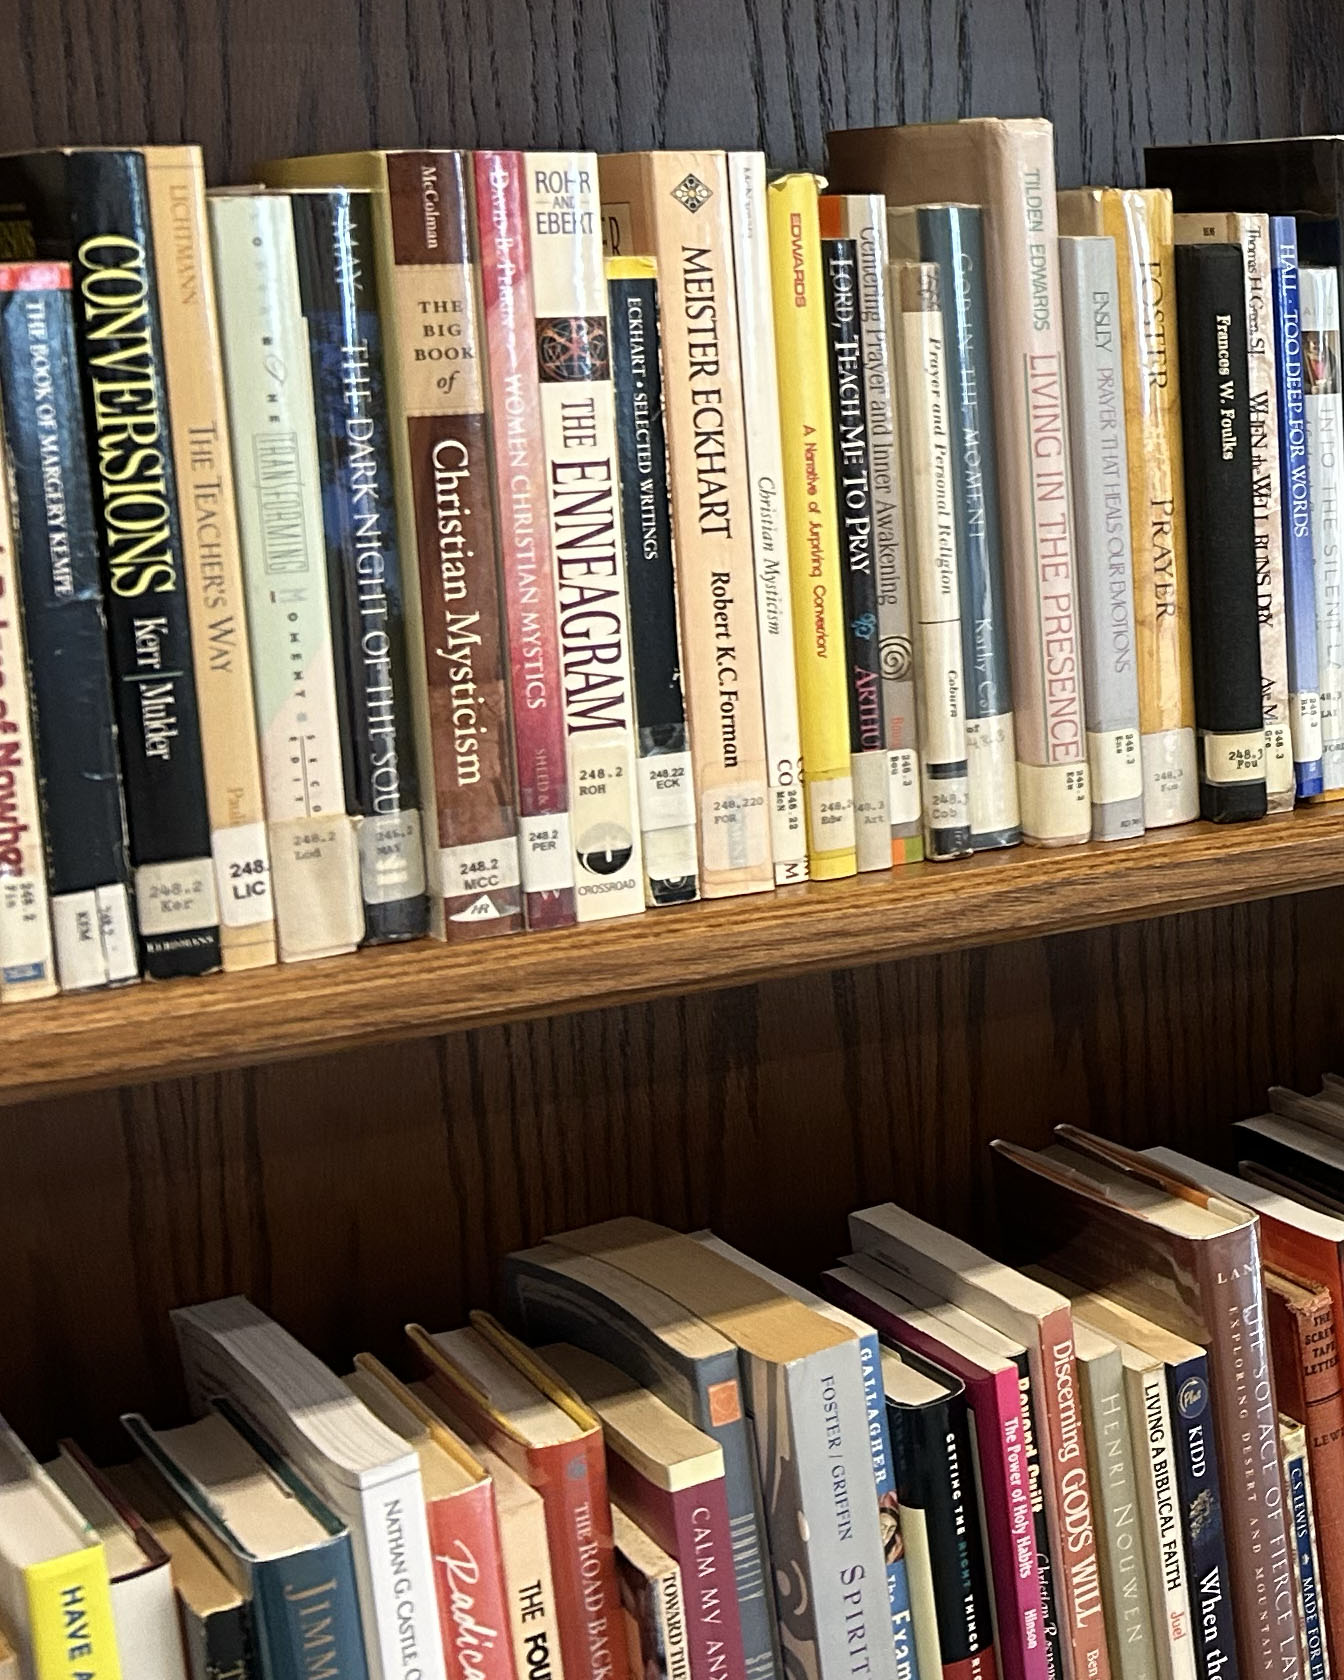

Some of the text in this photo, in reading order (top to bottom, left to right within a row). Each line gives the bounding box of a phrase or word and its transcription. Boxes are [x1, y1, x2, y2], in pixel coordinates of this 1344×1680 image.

[420, 165, 439, 250] McColman
[536, 171, 590, 193] ROHR
[536, 212, 593, 235] EBERT
[552, 196, 575, 207] AND
[418, 300, 464, 314] THE
[790, 212, 806, 308] EDWARDS
[1023, 168, 1050, 331] TILDEN EDWARDS
[414, 345, 475, 361] BOOK
[423, 323, 462, 338] BIG
[436, 371, 459, 392] of
[681, 245, 732, 540] MEISTER ECKHART
[1216, 315, 1235, 461] Frances W. Foulks
[77, 235, 177, 599] CONVERSIONS
[628, 297, 658, 560] ECKHART SELECTED WRITINGS
[830, 259, 872, 575] LORD, TEACH ME TO PRAY
[430, 439, 486, 787] Christian Mysticism
[551, 398, 627, 734] THE ENNEAGRAM
[710, 571, 730, 643] Robert
[1027, 353, 1079, 761] LIVING IN THE PRESENCE
[1151, 498, 1175, 621] PRAYER
[134, 618, 179, 760] Kerr Mulder
[719, 691, 739, 768] Forman
[579, 768, 623, 780] 248.2
[579, 784, 606, 796] ROH
[650, 767, 685, 781] 248.22
[656, 778, 680, 789] ECK
[821, 1376, 852, 1542] FOSTER GRIFFIN
[860, 1347, 887, 1484] GALLAGHER
[1187, 1426, 1206, 1478] KIDD
[1003, 1419, 1038, 1649] The Power of Holy Habits Hinson
[1053, 1341, 1100, 1628] Discerning GOD'S WILL
[1101, 1394, 1143, 1644] HENRI NOUWEN
[1144, 1384, 1185, 1641] LIVING A BIBLICAL FAITH Juel
[383, 1500, 419, 1663] NATHAN G. CASTLE
